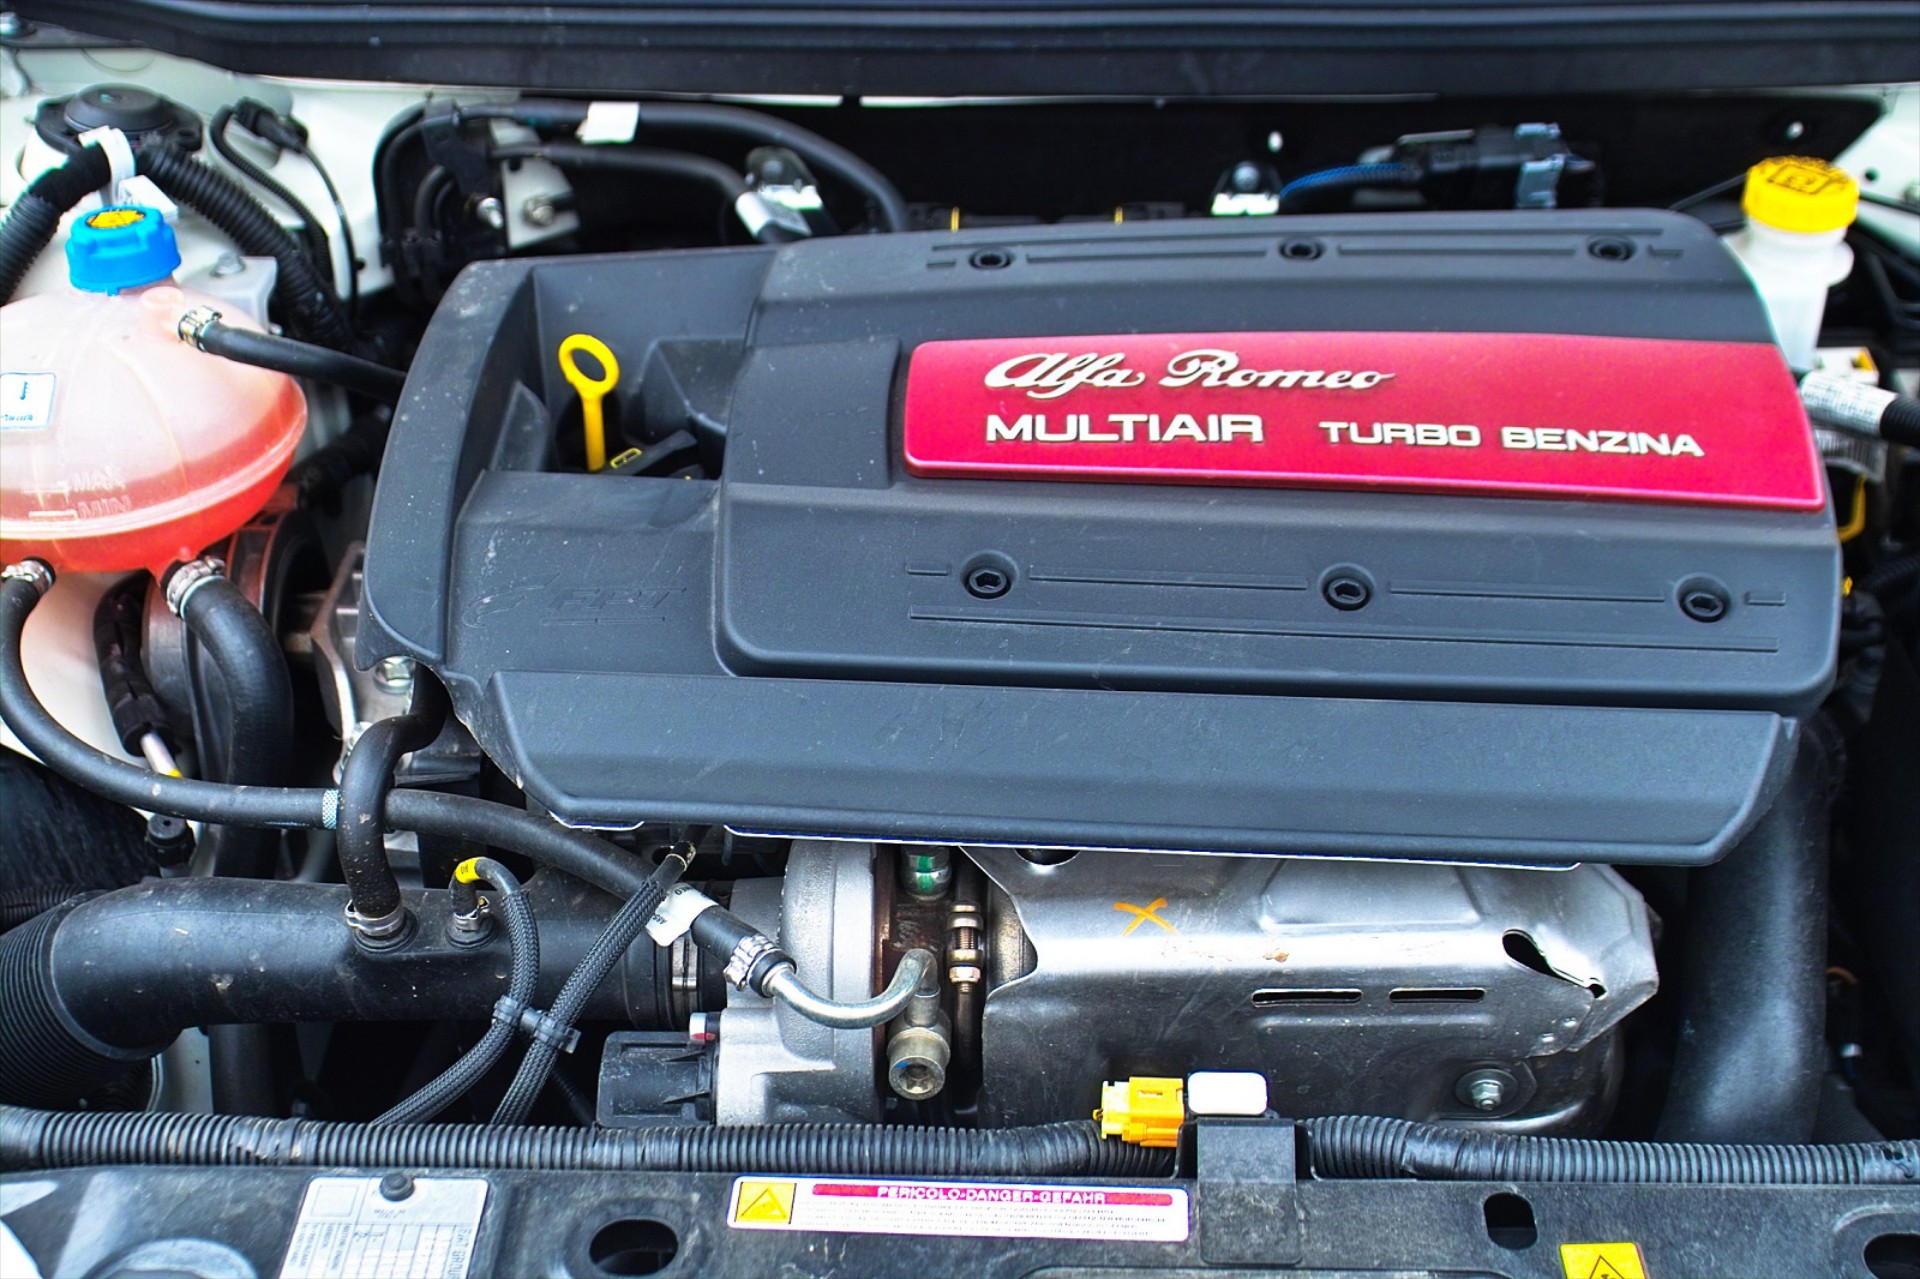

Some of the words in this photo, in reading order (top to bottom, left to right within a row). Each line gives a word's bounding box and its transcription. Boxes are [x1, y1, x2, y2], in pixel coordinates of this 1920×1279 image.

[983, 352, 1147, 400] Alfa
[1158, 348, 1396, 389] Romeo
[986, 414, 1264, 444] MULTIAIR
[1318, 421, 1481, 447] TURBO
[1501, 426, 1706, 457] BENZINA
[77, 494, 132, 520] MIN
